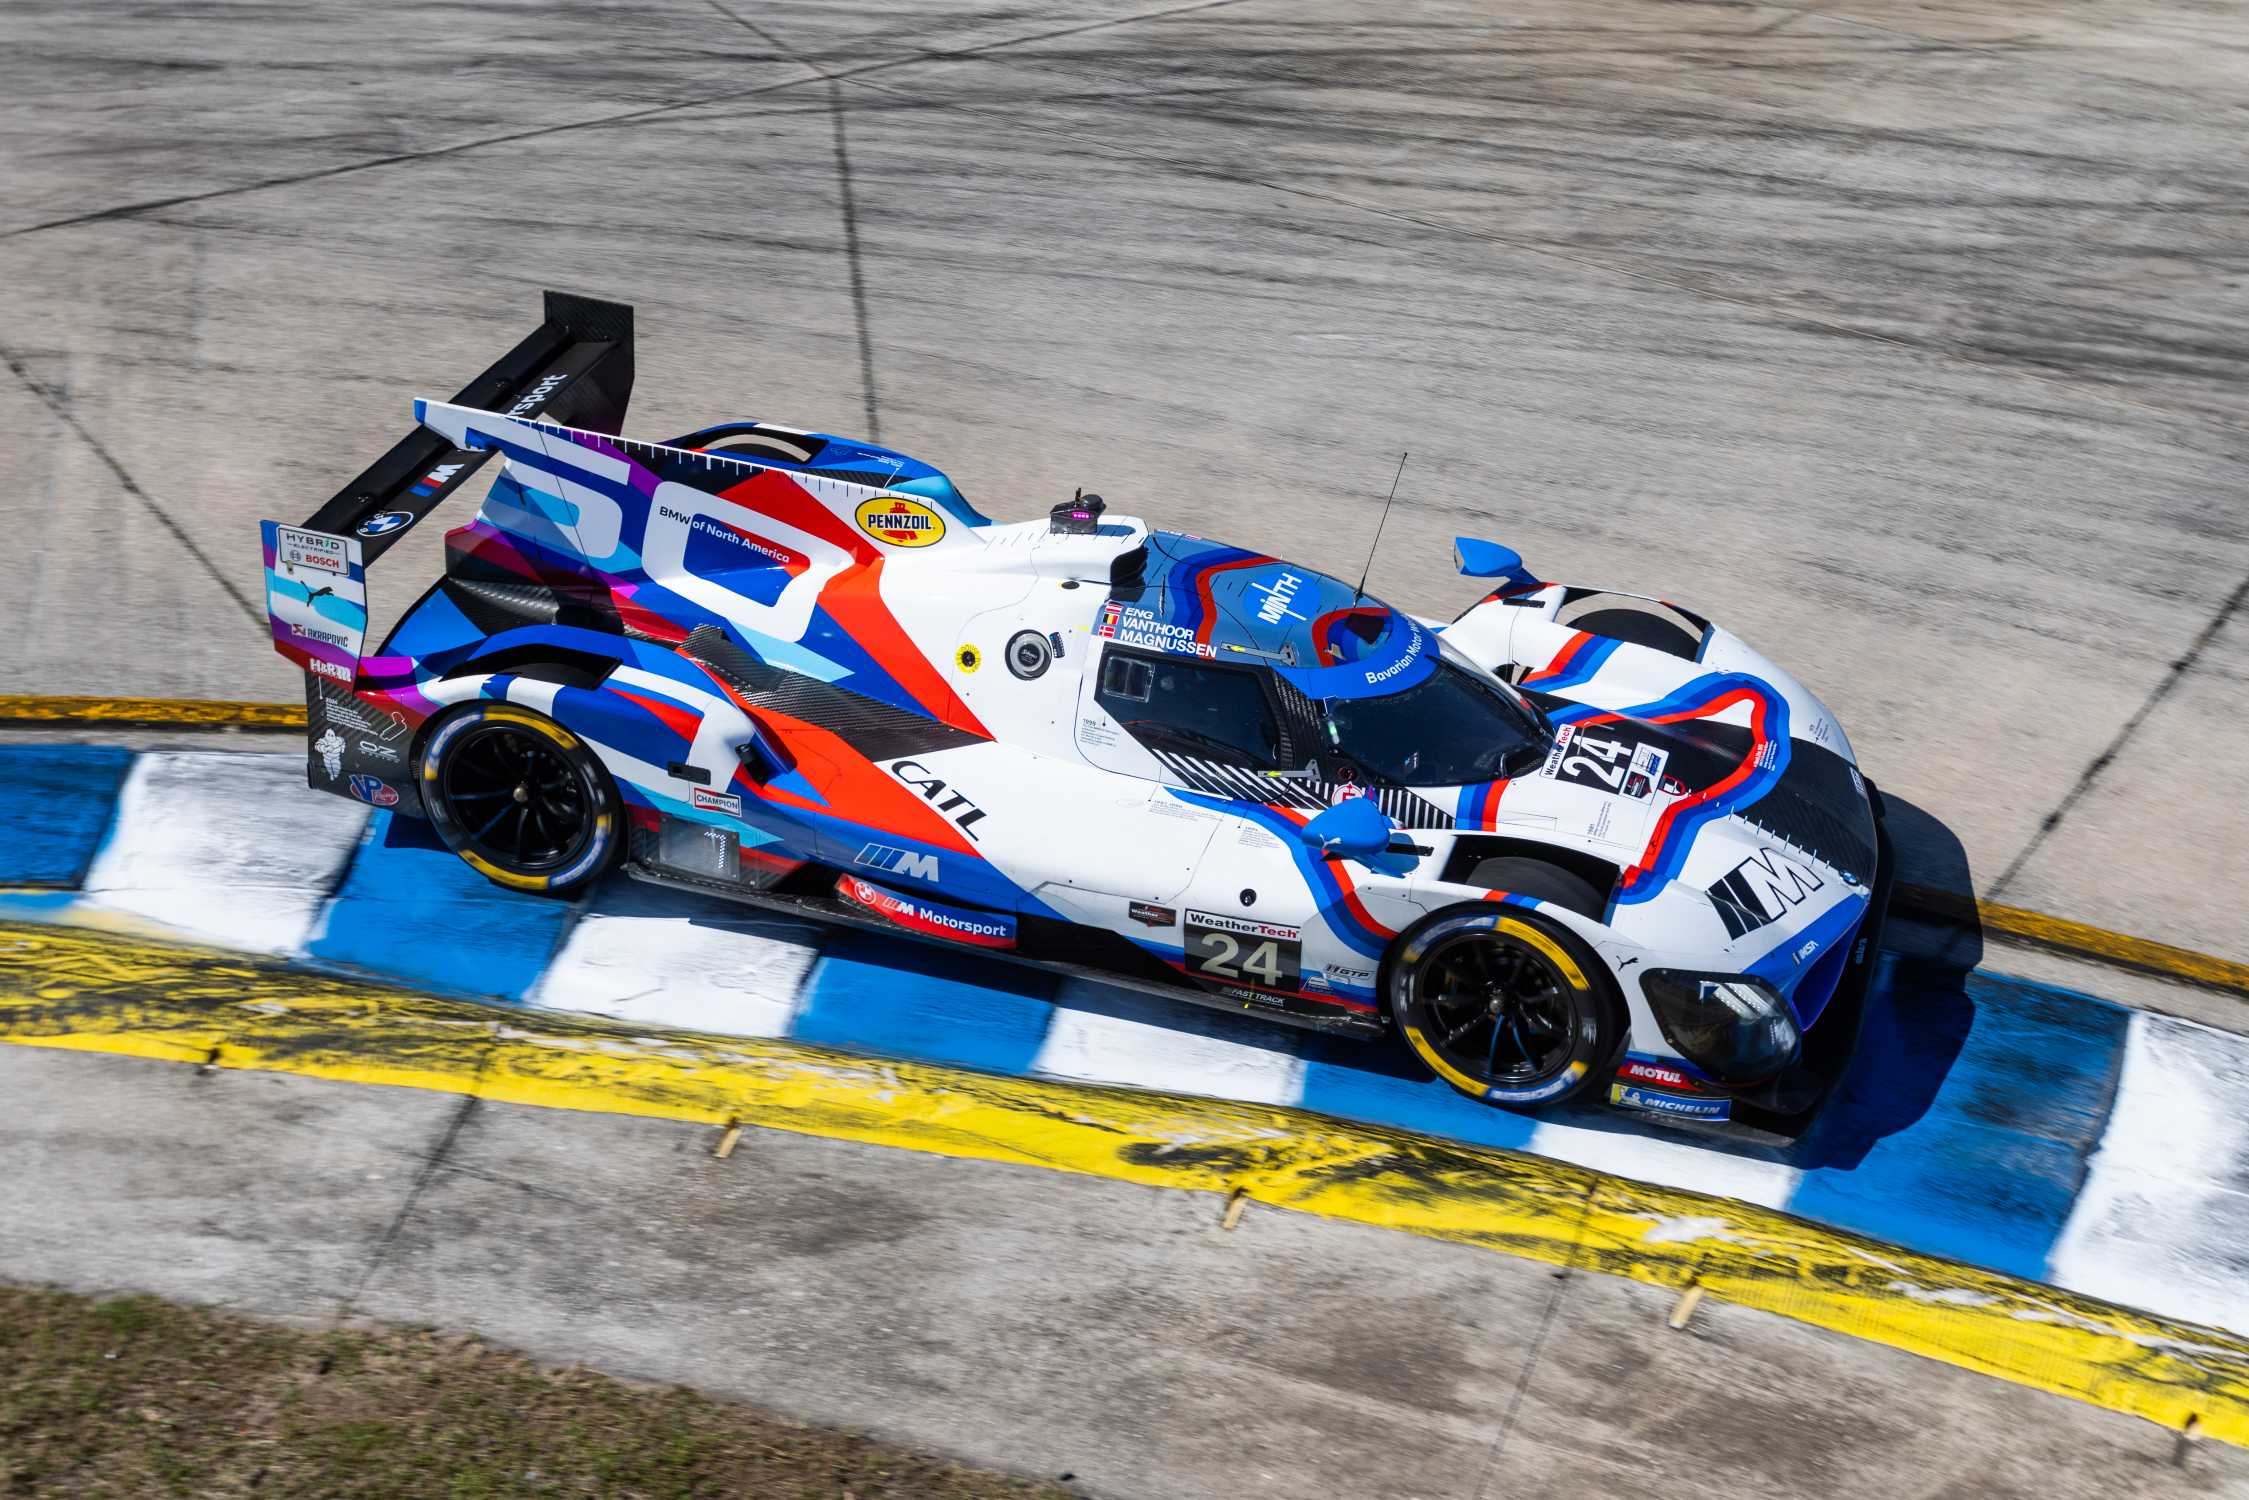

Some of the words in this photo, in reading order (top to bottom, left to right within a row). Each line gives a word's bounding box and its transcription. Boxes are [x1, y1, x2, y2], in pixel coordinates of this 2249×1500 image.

[659, 505, 691, 526] BMW
[692, 519, 706, 531] of
[706, 525, 740, 545] North
[741, 537, 790, 564] America
[867, 513, 934, 531] PENNZOIL
[305, 554, 340, 569] BOSCH
[1125, 607, 1153, 620] ENG
[1122, 616, 1194, 641] VANTHOOR
[1120, 628, 1217, 658] MAGNUSSEN
[1365, 655, 1412, 685] Bavarian
[1409, 631, 1426, 657] Motor
[1562, 736, 1634, 789] 24
[696, 793, 740, 812] CHAMPION
[892, 760, 988, 841] CATL
[919, 906, 1007, 937] Motorsport
[1190, 912, 1298, 939] WeatherTech
[1201, 932, 1283, 987] 24
[1255, 992, 1286, 1006] TRACK
[1630, 1064, 1682, 1084] MOTUL
[1644, 1097, 1721, 1115] MICHELIN
